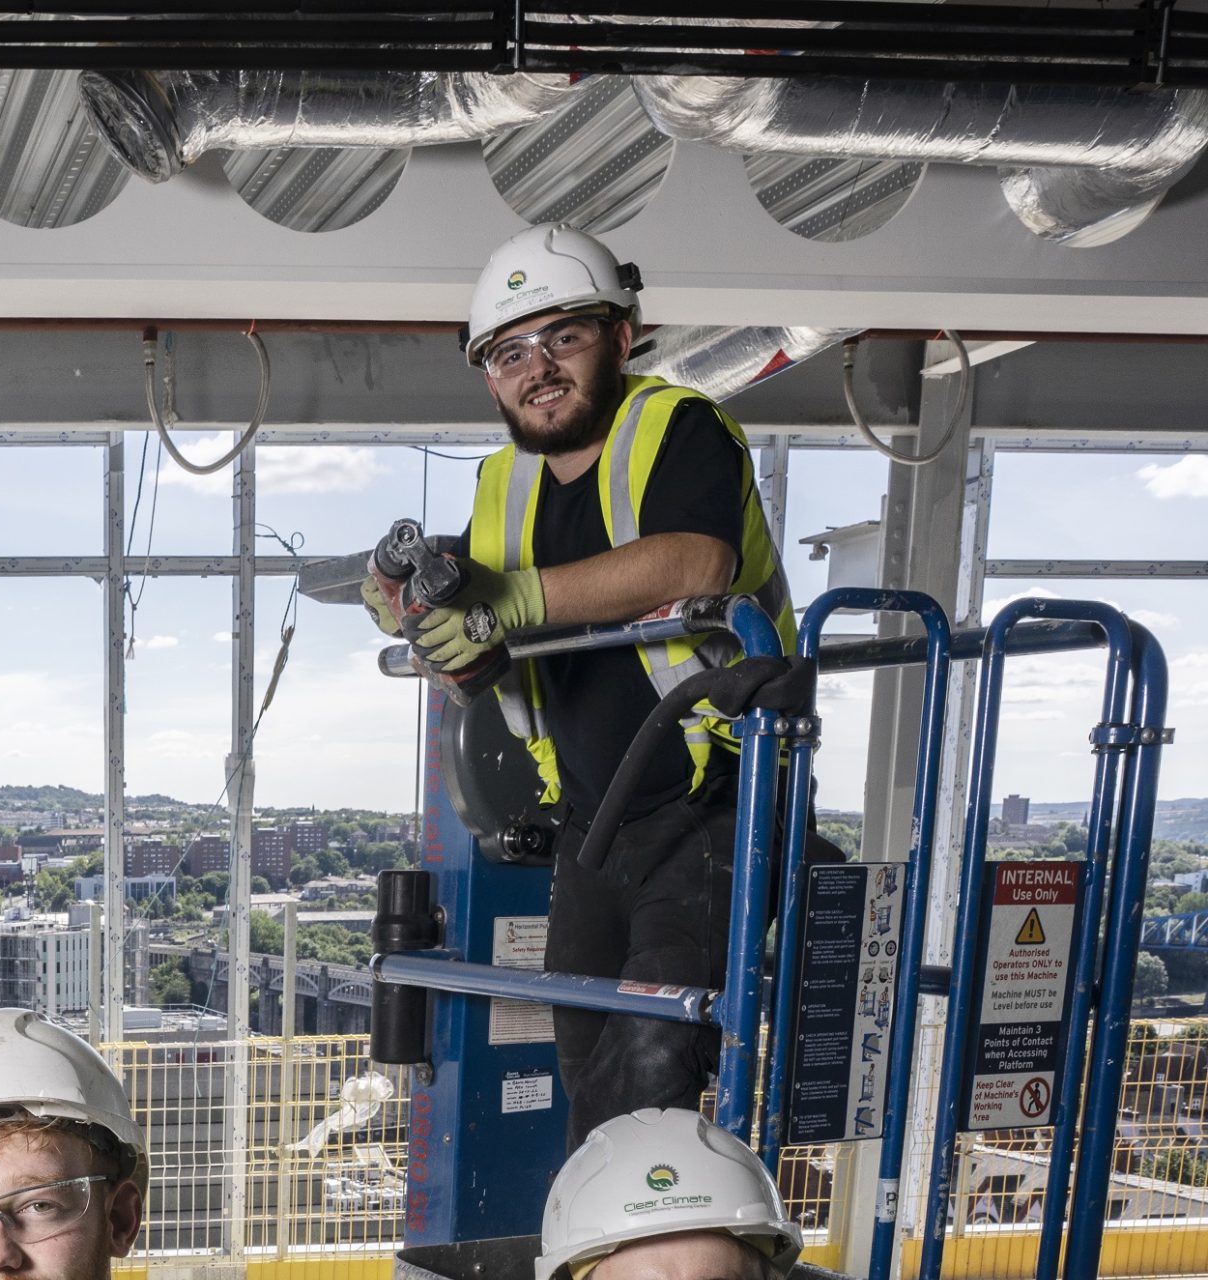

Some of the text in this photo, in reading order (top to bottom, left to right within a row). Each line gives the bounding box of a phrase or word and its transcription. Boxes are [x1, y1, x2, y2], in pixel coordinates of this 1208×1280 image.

[1001, 870, 1072, 885] INTERNAL
[1012, 888, 1059, 902] Use Only
[1009, 949, 1050, 957] Authorised
[993, 959, 1062, 970] Operators ONLY to
[995, 971, 1058, 981] use this Machine
[991, 989, 1057, 1000] Machine MUST be
[993, 1000, 1053, 1010] Level before use
[999, 1025, 1042, 1036] Maintain 3
[984, 1036, 1054, 1048] Points of Contact
[984, 1048, 1048, 1059] when Accessing
[998, 1060, 1034, 1070] Platform
[976, 1080, 1015, 1090] Keep Clear
[975, 1090, 1019, 1100] of Machine's
[974, 1102, 1002, 1111] Working
[973, 1113, 990, 1121] Area
[623, 1195, 712, 1213] Clear Climate
